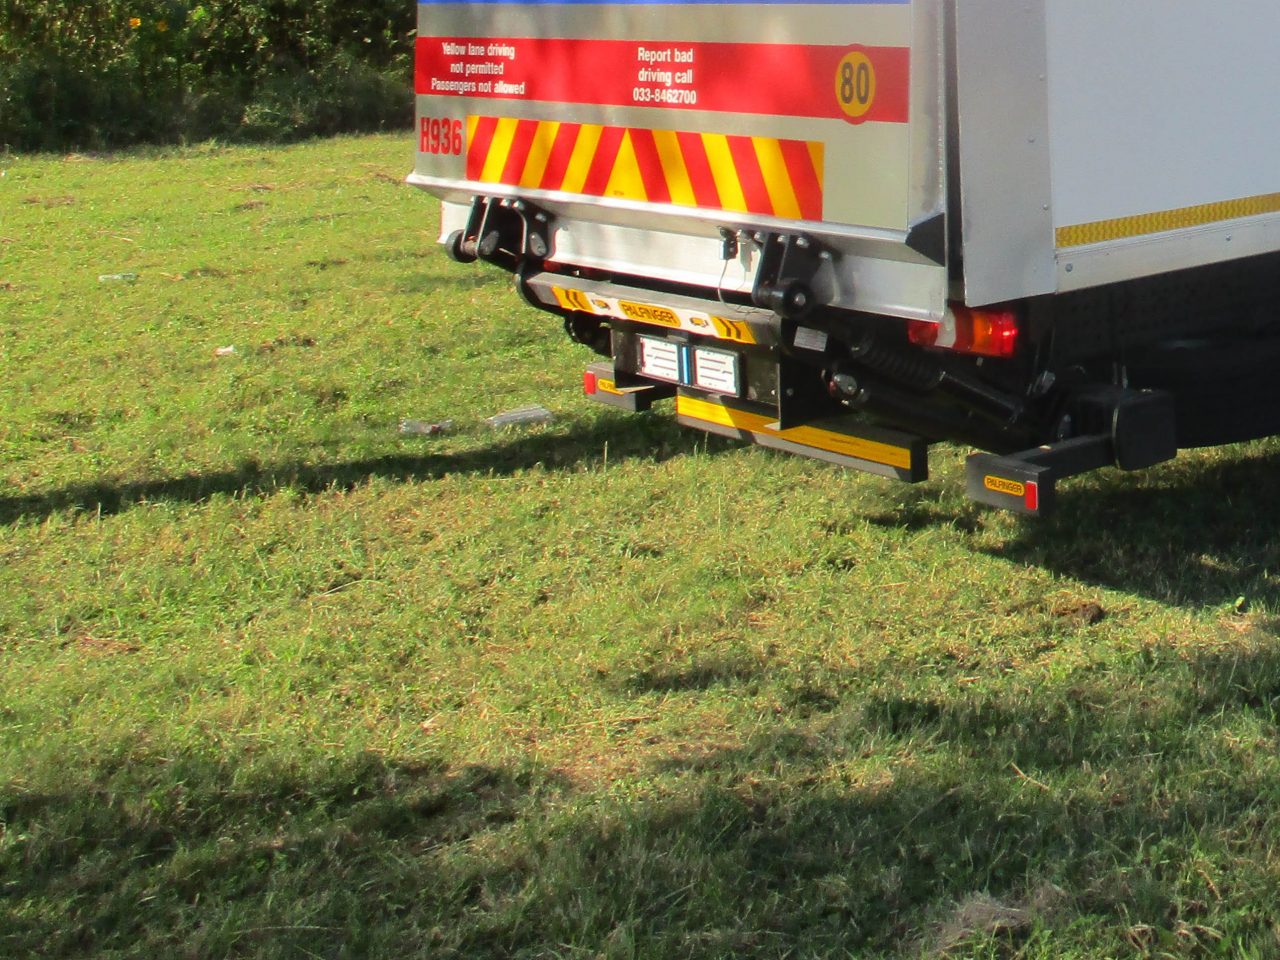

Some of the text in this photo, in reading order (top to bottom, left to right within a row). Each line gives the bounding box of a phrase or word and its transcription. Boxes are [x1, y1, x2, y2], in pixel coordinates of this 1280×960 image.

[442, 42, 516, 60] Yellow lane driving
[637, 47, 694, 65] Report bad
[449, 62, 505, 77] not permitted
[637, 67, 693, 87] driving call
[431, 77, 526, 95] Passengers not allowed
[840, 61, 870, 105] 80
[632, 87, 697, 105] 033-8462700
[419, 116, 463, 156] H936
[621, 302, 675, 324] PALFINGER
